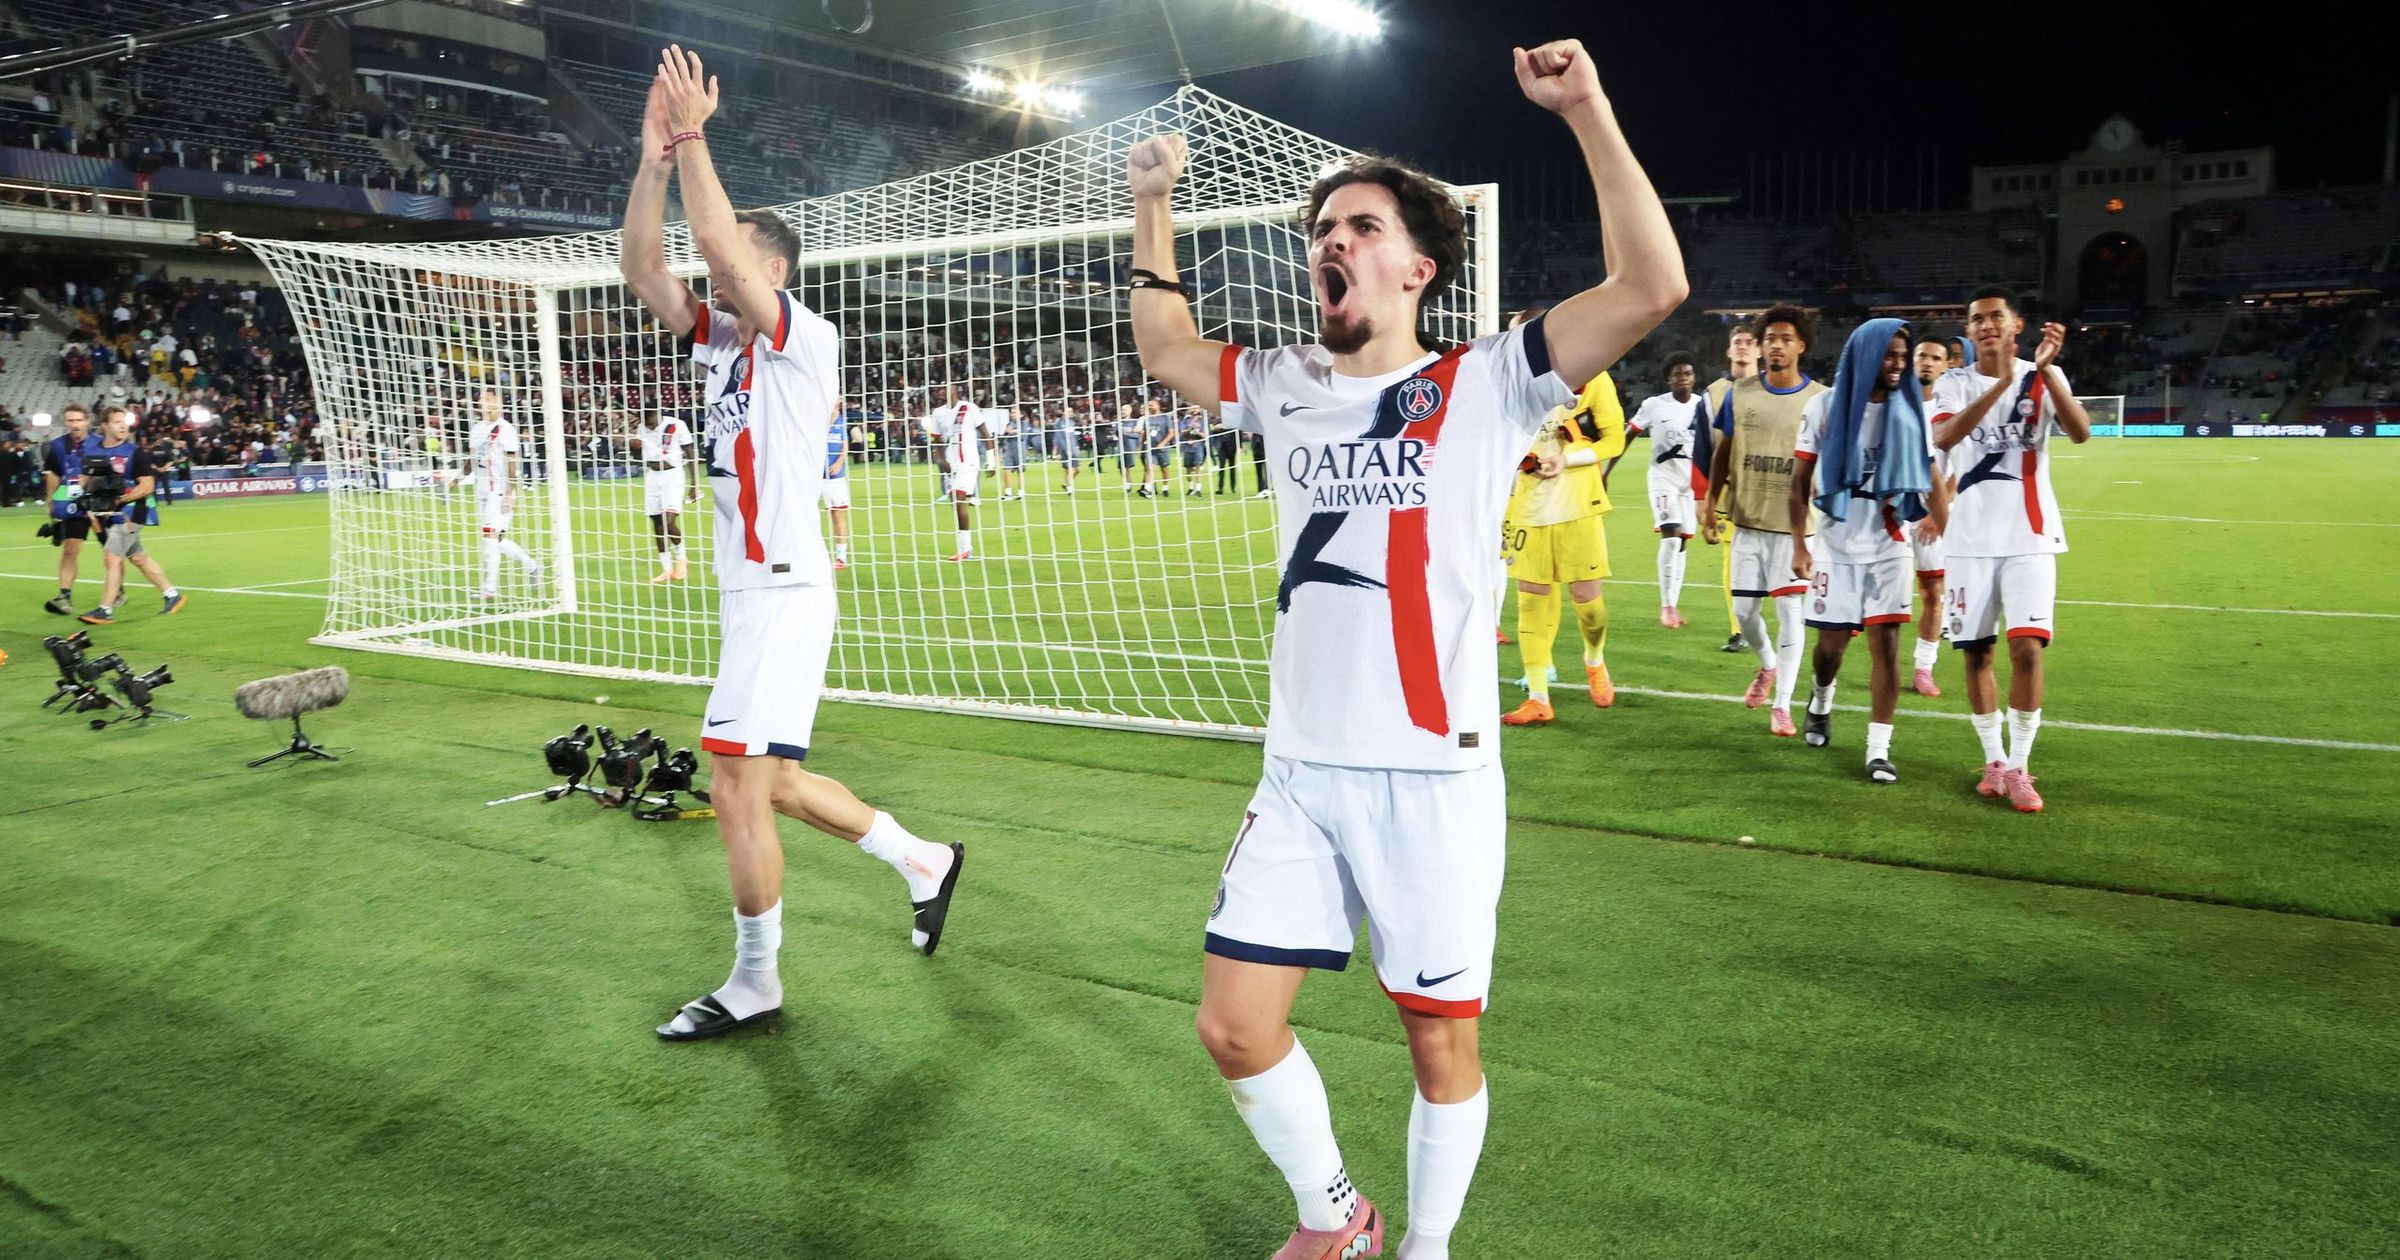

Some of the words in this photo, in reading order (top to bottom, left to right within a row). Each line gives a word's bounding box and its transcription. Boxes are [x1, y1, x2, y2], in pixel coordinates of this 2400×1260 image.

[490, 207, 517, 217] UEFA
[1403, 380, 1434, 393] PARIS
[1969, 423, 2033, 445] QATAR
[1288, 439, 1426, 490] QATAR
[1743, 452, 1795, 475] #FOOTBA
[191, 481, 239, 496] QATAR
[240, 479, 296, 493] AIRWAYS
[1312, 482, 1426, 507] AIRWAYS
